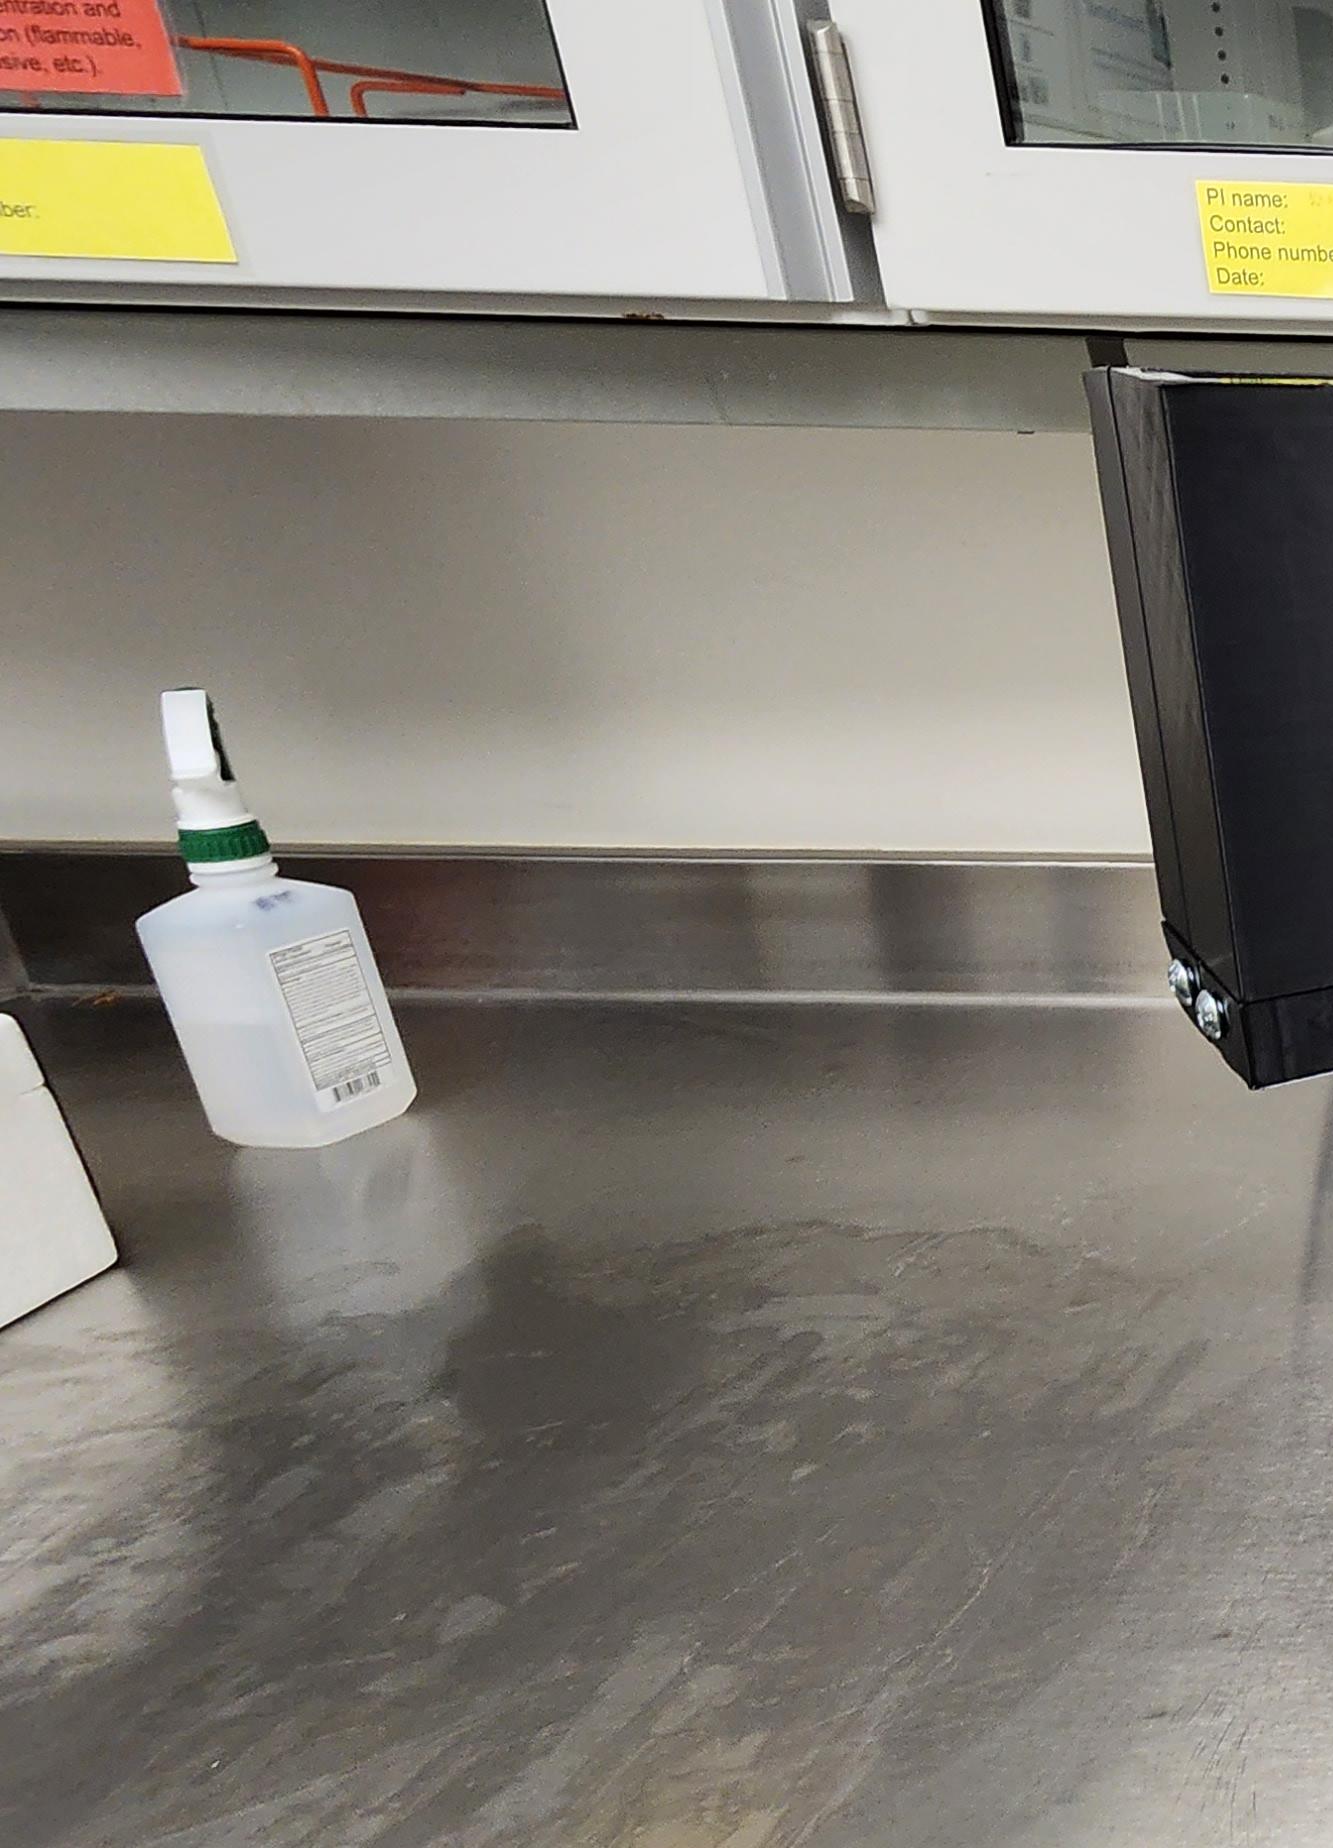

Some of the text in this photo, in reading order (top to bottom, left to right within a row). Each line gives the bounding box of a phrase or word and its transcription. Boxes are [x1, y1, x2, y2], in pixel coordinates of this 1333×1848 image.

[84, 0, 121, 18] and
[1206, 188, 1288, 208] PI name:
[1209, 214, 1286, 234] Contact:
[1213, 241, 1272, 260] Phone
[1216, 267, 1265, 286] Date:
